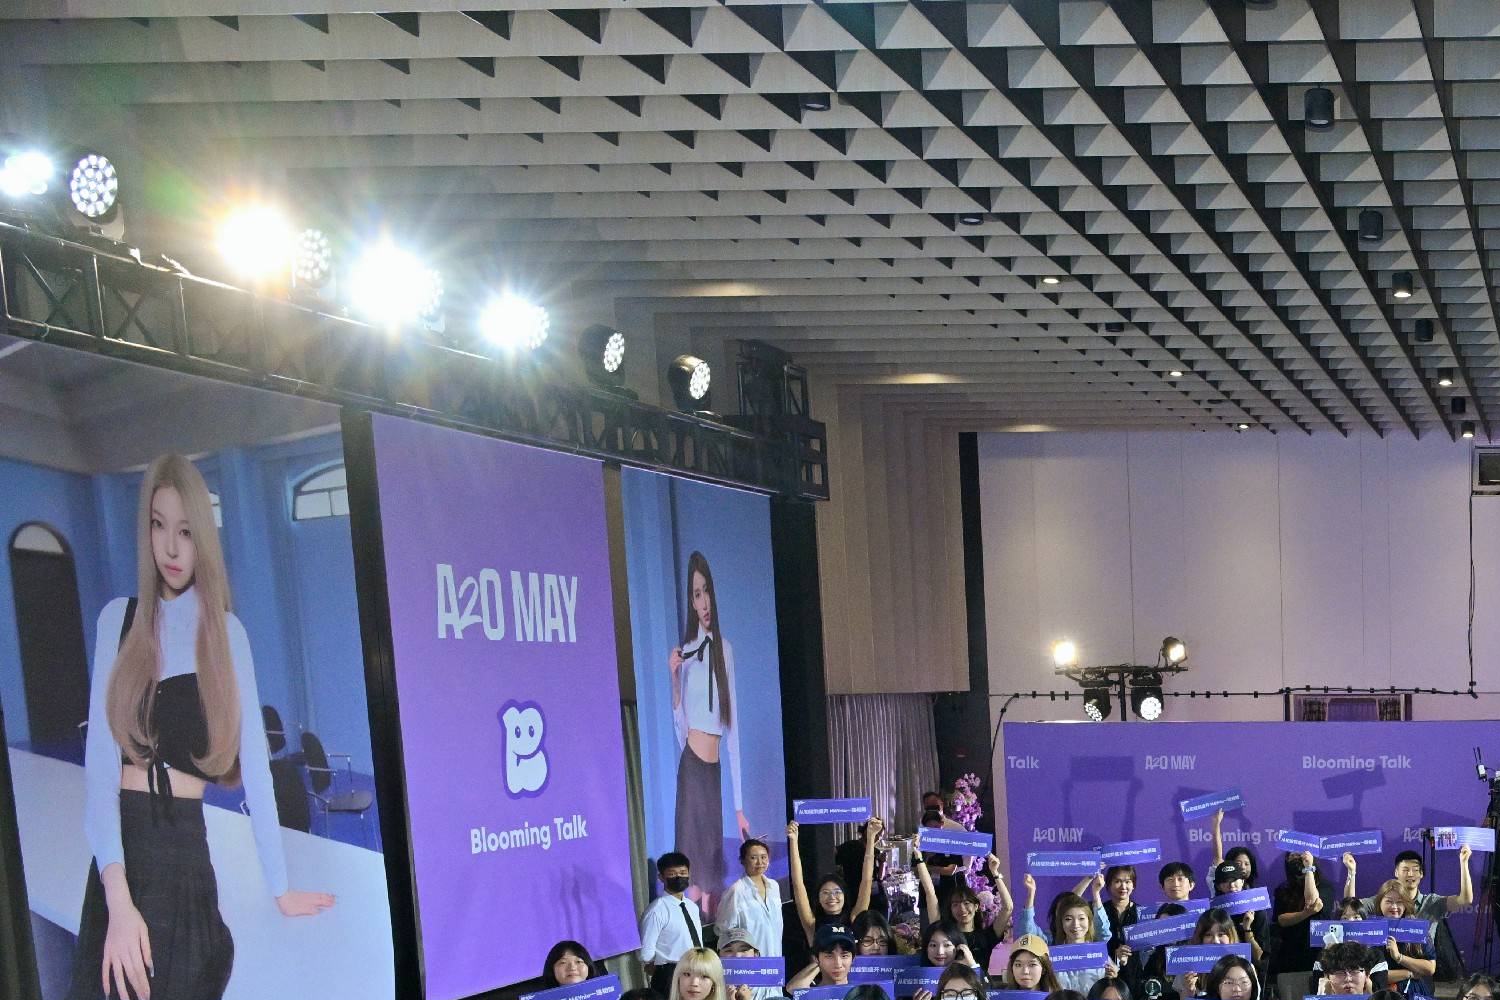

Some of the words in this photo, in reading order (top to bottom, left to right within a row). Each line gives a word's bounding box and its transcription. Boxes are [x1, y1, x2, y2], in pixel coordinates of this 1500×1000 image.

[511, 570, 578, 643] MAY
[1008, 756, 1039, 769] Talk
[1171, 755, 1196, 770] MAY
[1302, 756, 1375, 772] Blooming
[1379, 755, 1412, 769] Talk
[470, 821, 551, 854] Blooming
[554, 815, 588, 841] Talk
[1059, 827, 1084, 842] MAY
[1189, 829, 1261, 844] Bloming
